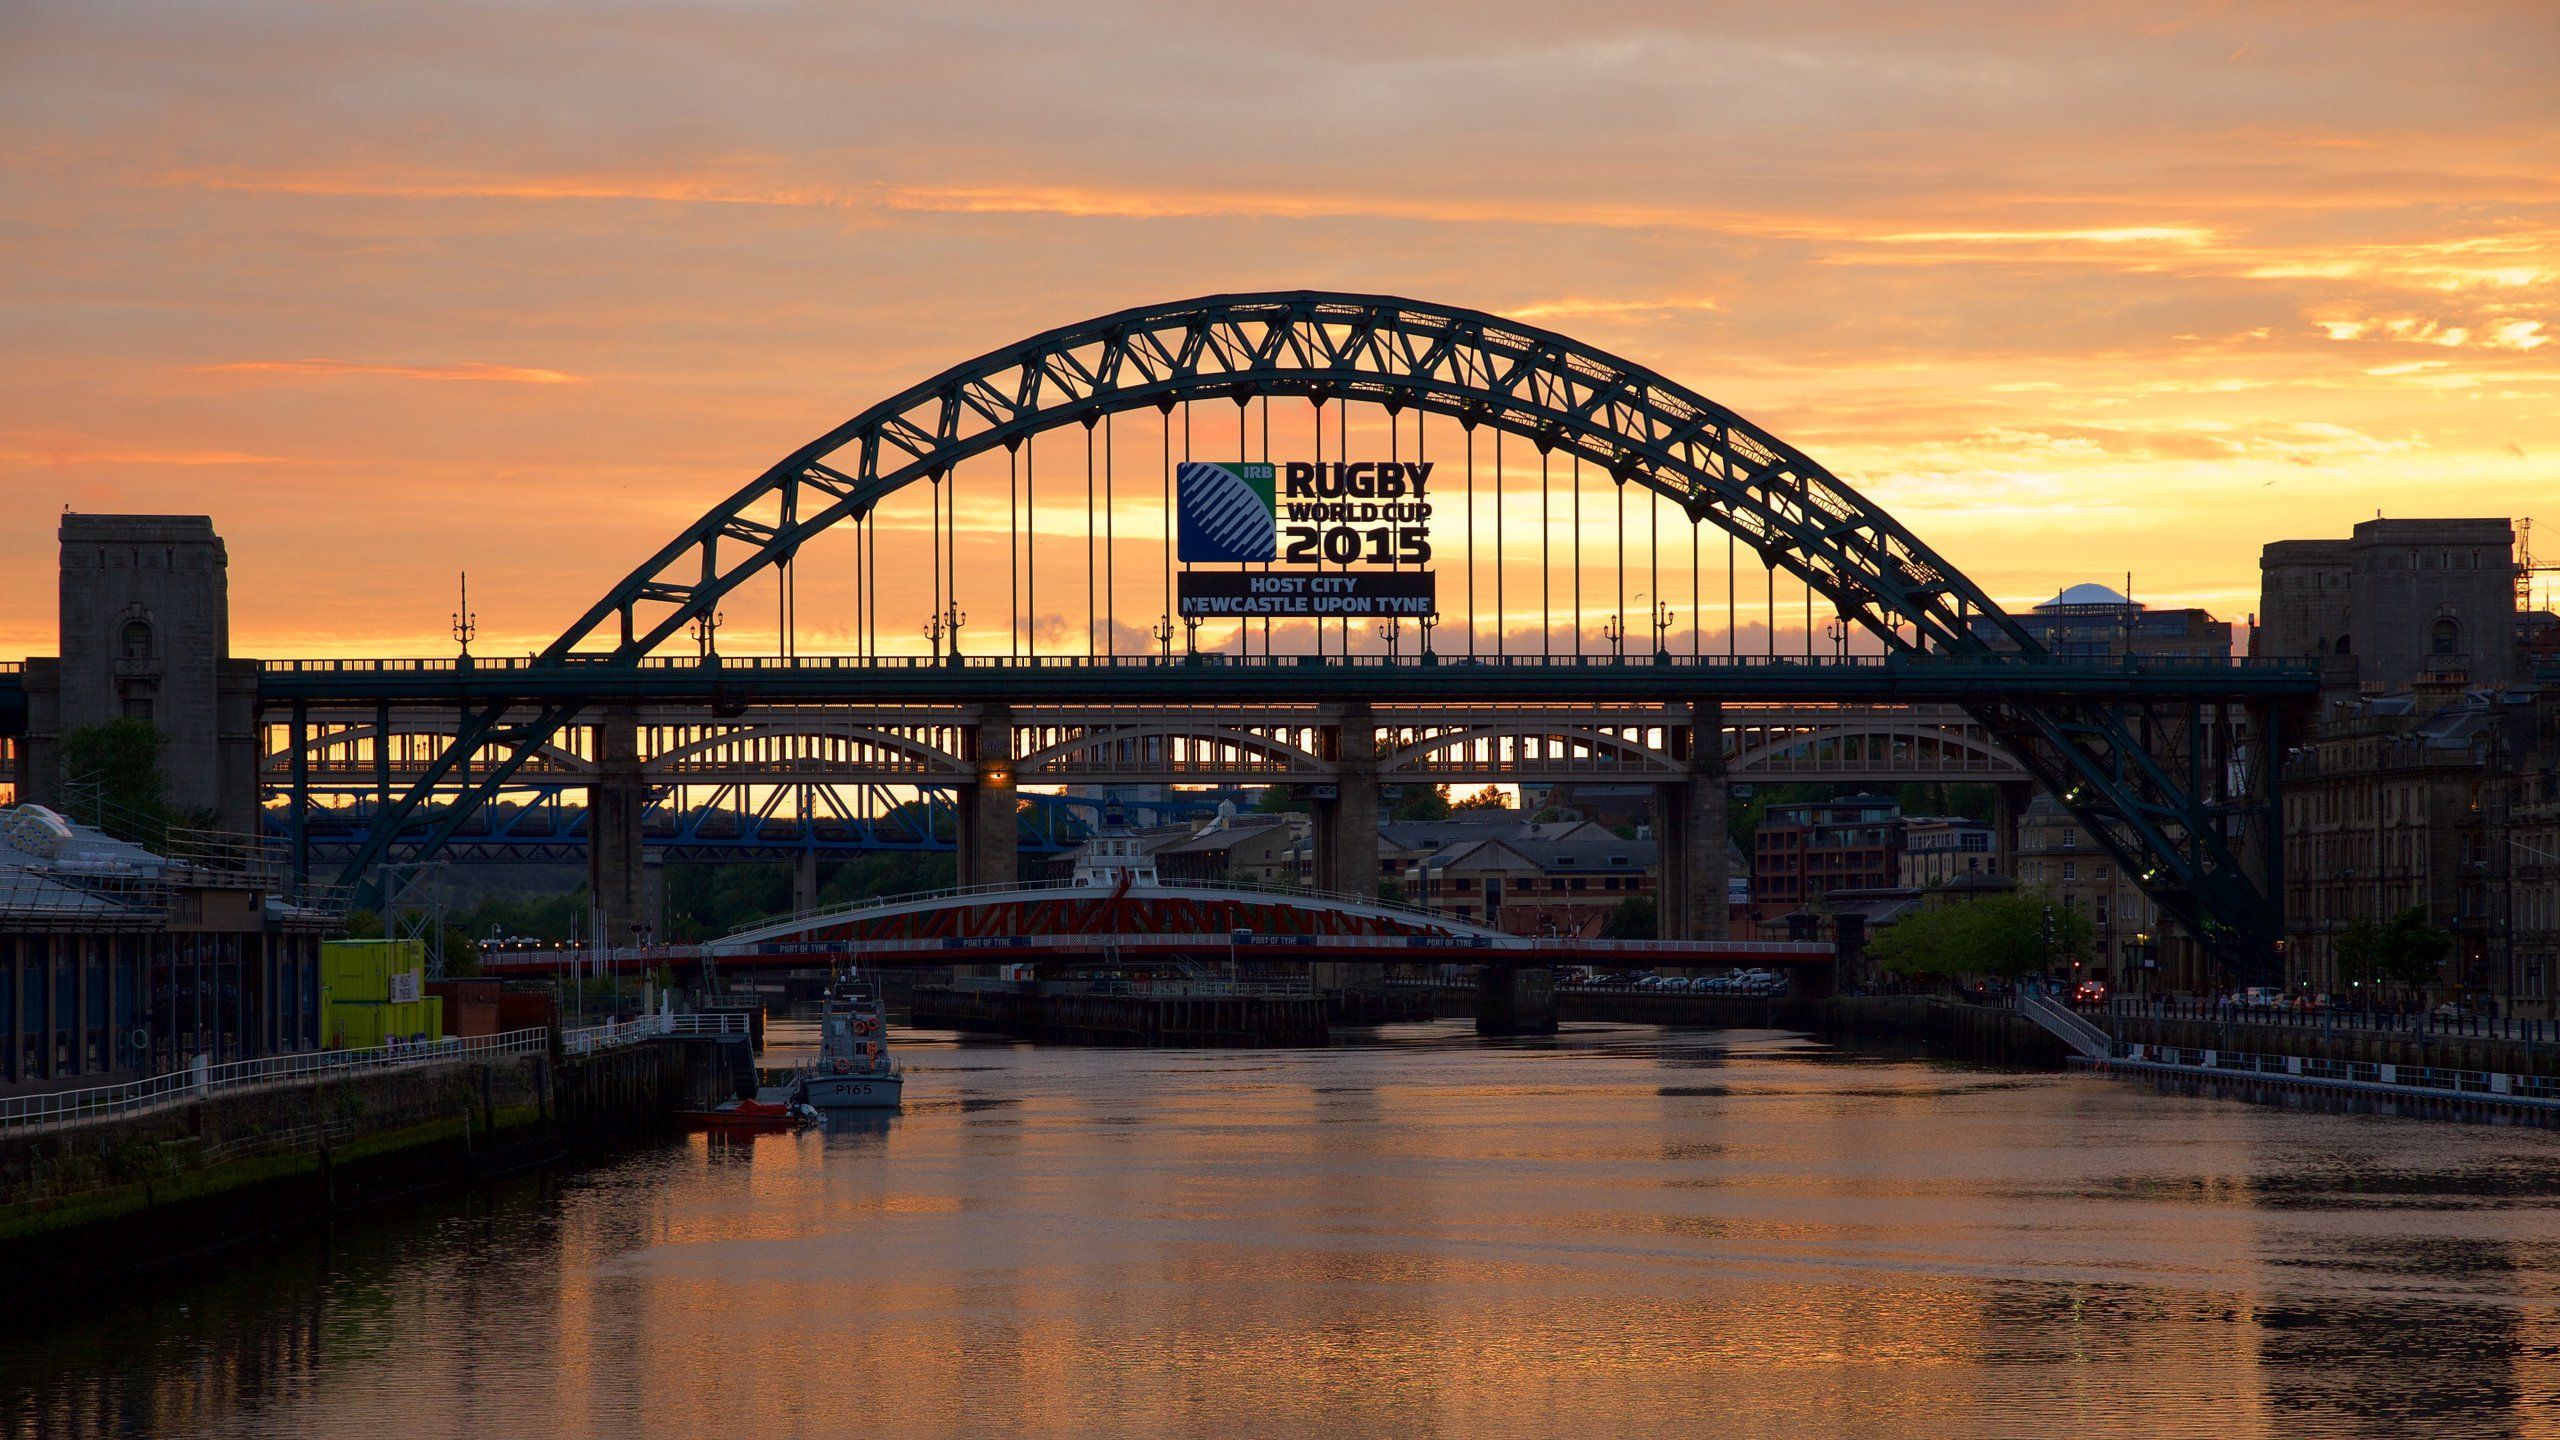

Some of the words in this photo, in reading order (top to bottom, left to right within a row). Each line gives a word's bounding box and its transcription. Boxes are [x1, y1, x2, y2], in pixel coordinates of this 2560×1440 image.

[1243, 466, 1273, 479] IRB
[1286, 462, 1434, 498] RUGBY
[1287, 503, 1378, 522] WORLD
[1382, 503, 1432, 522] CUP
[1286, 526, 1432, 564] 2015
[1250, 577, 1307, 593] HOST
[1310, 577, 1358, 593] CITY
[1182, 596, 1309, 613] NEWCASTLE
[1313, 596, 1372, 613] UPON
[1375, 596, 1431, 613] TYNE
[963, 938, 981, 947] PORT
[983, 938, 992, 947] OF
[994, 937, 1011, 947] TYNE
[1250, 936, 1268, 945] PORT
[1270, 936, 1279, 945] OF
[1281, 936, 1298, 945] TYNE
[1426, 939, 1444, 947] PORT
[1445, 939, 1455, 947] OF
[1456, 939, 1473, 947] TYNE
[780, 944, 798, 953] PORT
[800, 944, 809, 953] OF
[811, 943, 828, 952] TYNE
[836, 1084, 872, 1095] P165
